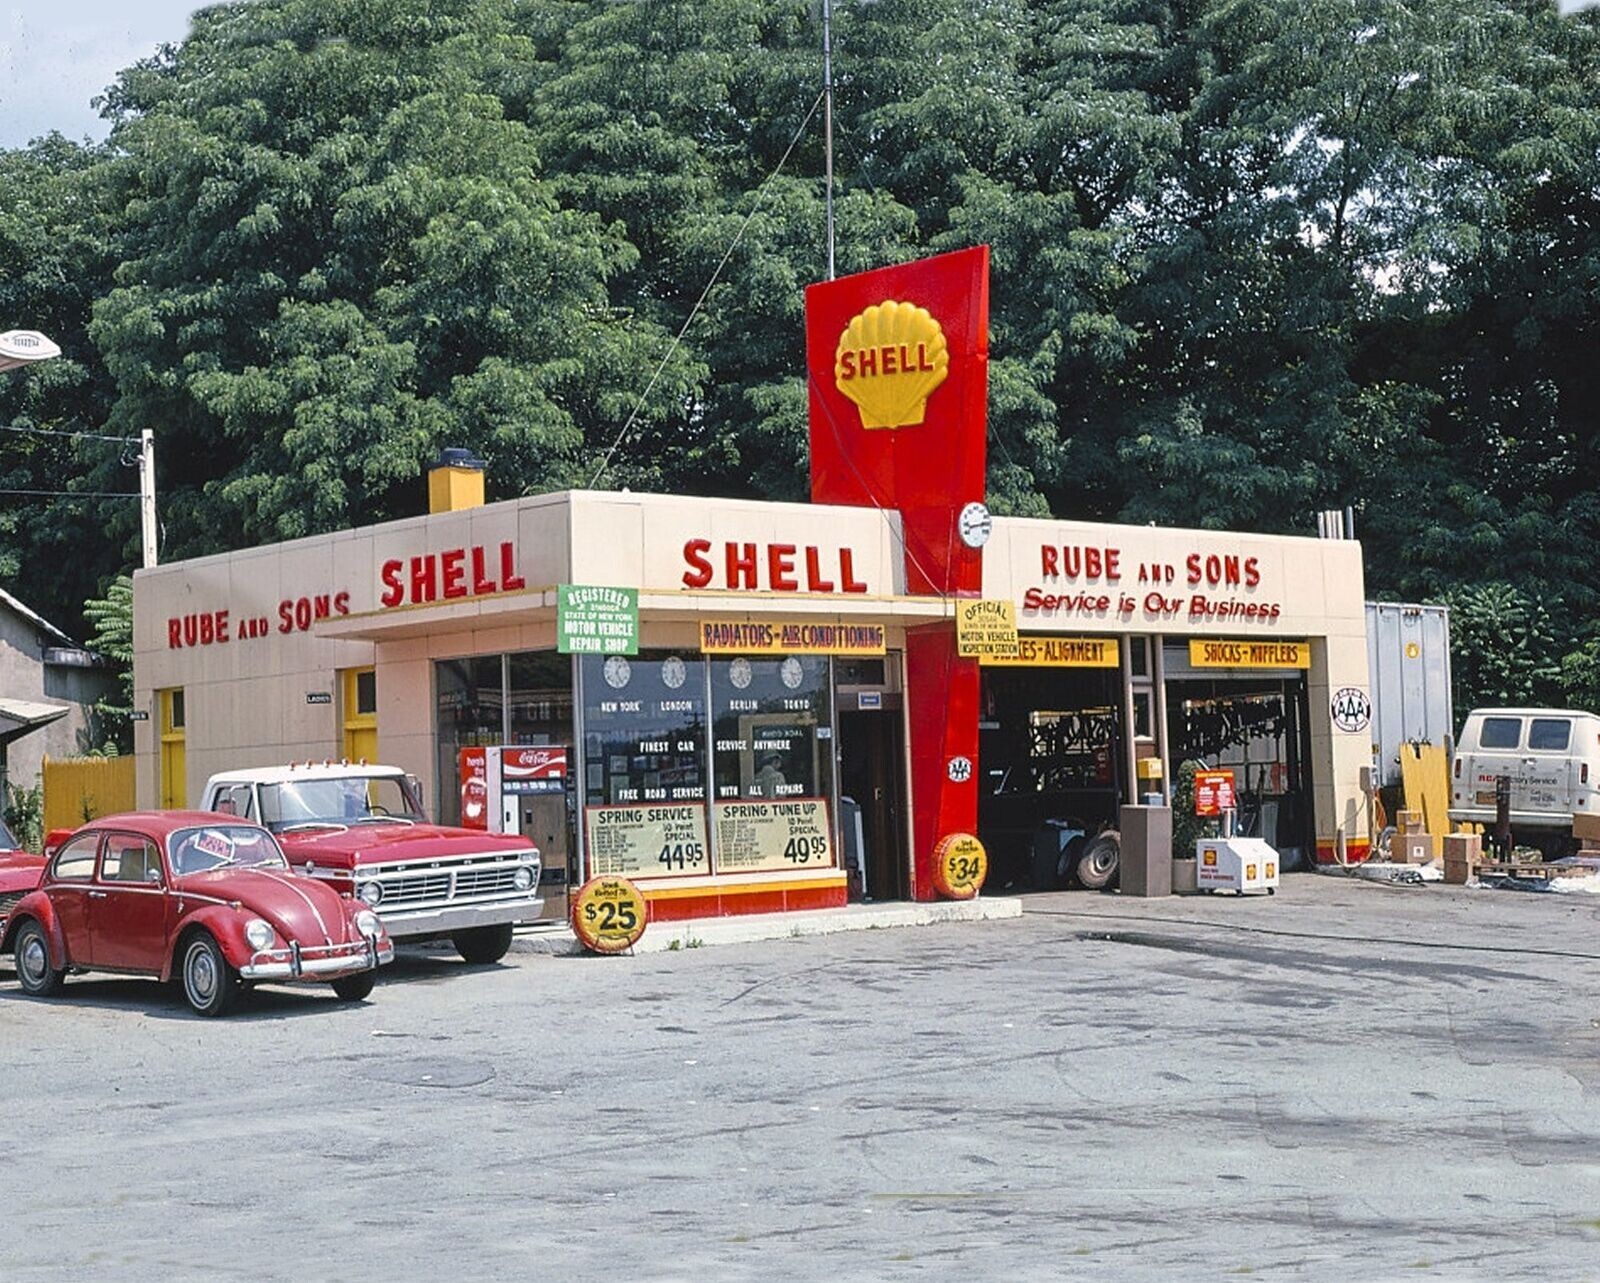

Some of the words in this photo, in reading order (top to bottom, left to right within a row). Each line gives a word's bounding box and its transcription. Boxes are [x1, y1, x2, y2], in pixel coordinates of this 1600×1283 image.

[840, 343, 934, 380] SHELL
[681, 538, 867, 593] SHELL
[1041, 544, 1121, 580] RUBE
[1138, 563, 1174, 582] AND
[1187, 553, 1261, 587] SONS
[380, 541, 525, 608] SHELL
[568, 588, 630, 608] REGISTERED
[1023, 587, 1110, 611] Service
[1119, 591, 1136, 613] is
[1144, 592, 1184, 614] Our
[1189, 595, 1281, 618] Business
[964, 601, 1007, 620] OFFICIAL
[168, 610, 229, 649] RUBE
[238, 619, 269, 639] AND
[278, 591, 350, 634] SONS
[564, 620, 596, 635] MOTOR
[598, 622, 633, 637] VEHICLE
[960, 631, 984, 642] MOTOR
[987, 631, 1016, 642] VEHICLE
[569, 637, 601, 650] REPAIR
[605, 638, 628, 652] SHOP
[961, 643, 994, 653] INSPECTION
[995, 643, 1018, 653] STATION
[601, 701, 618, 712] NEW
[620, 701, 640, 712] YORK
[660, 701, 692, 711] LONDON
[730, 700, 758, 710] BERLIN
[784, 699, 810, 710] TOKYO
[1338, 696, 1365, 722] AAA
[640, 742, 669, 753] FINEST
[677, 741, 694, 752] CAR
[717, 740, 747, 751] SERVICE
[754, 740, 791, 750] ANYWHERE
[619, 789, 638, 800] FREE
[645, 788, 667, 799] ROAD
[672, 787, 704, 798] SERVICE
[720, 786, 738, 796] WITH
[749, 785, 763, 795] ALL
[776, 784, 804, 794] REPAIRS
[598, 810, 643, 824] SPRING
[648, 808, 694, 822] SERVICE
[723, 805, 768, 818] SPRING
[771, 803, 801, 816] TUNE
[803, 803, 817, 815] UP
[665, 832, 696, 842] SPECIAL
[789, 826, 820, 835] SPECIAL
[949, 857, 979, 880] $34
[585, 902, 637, 930] $25
